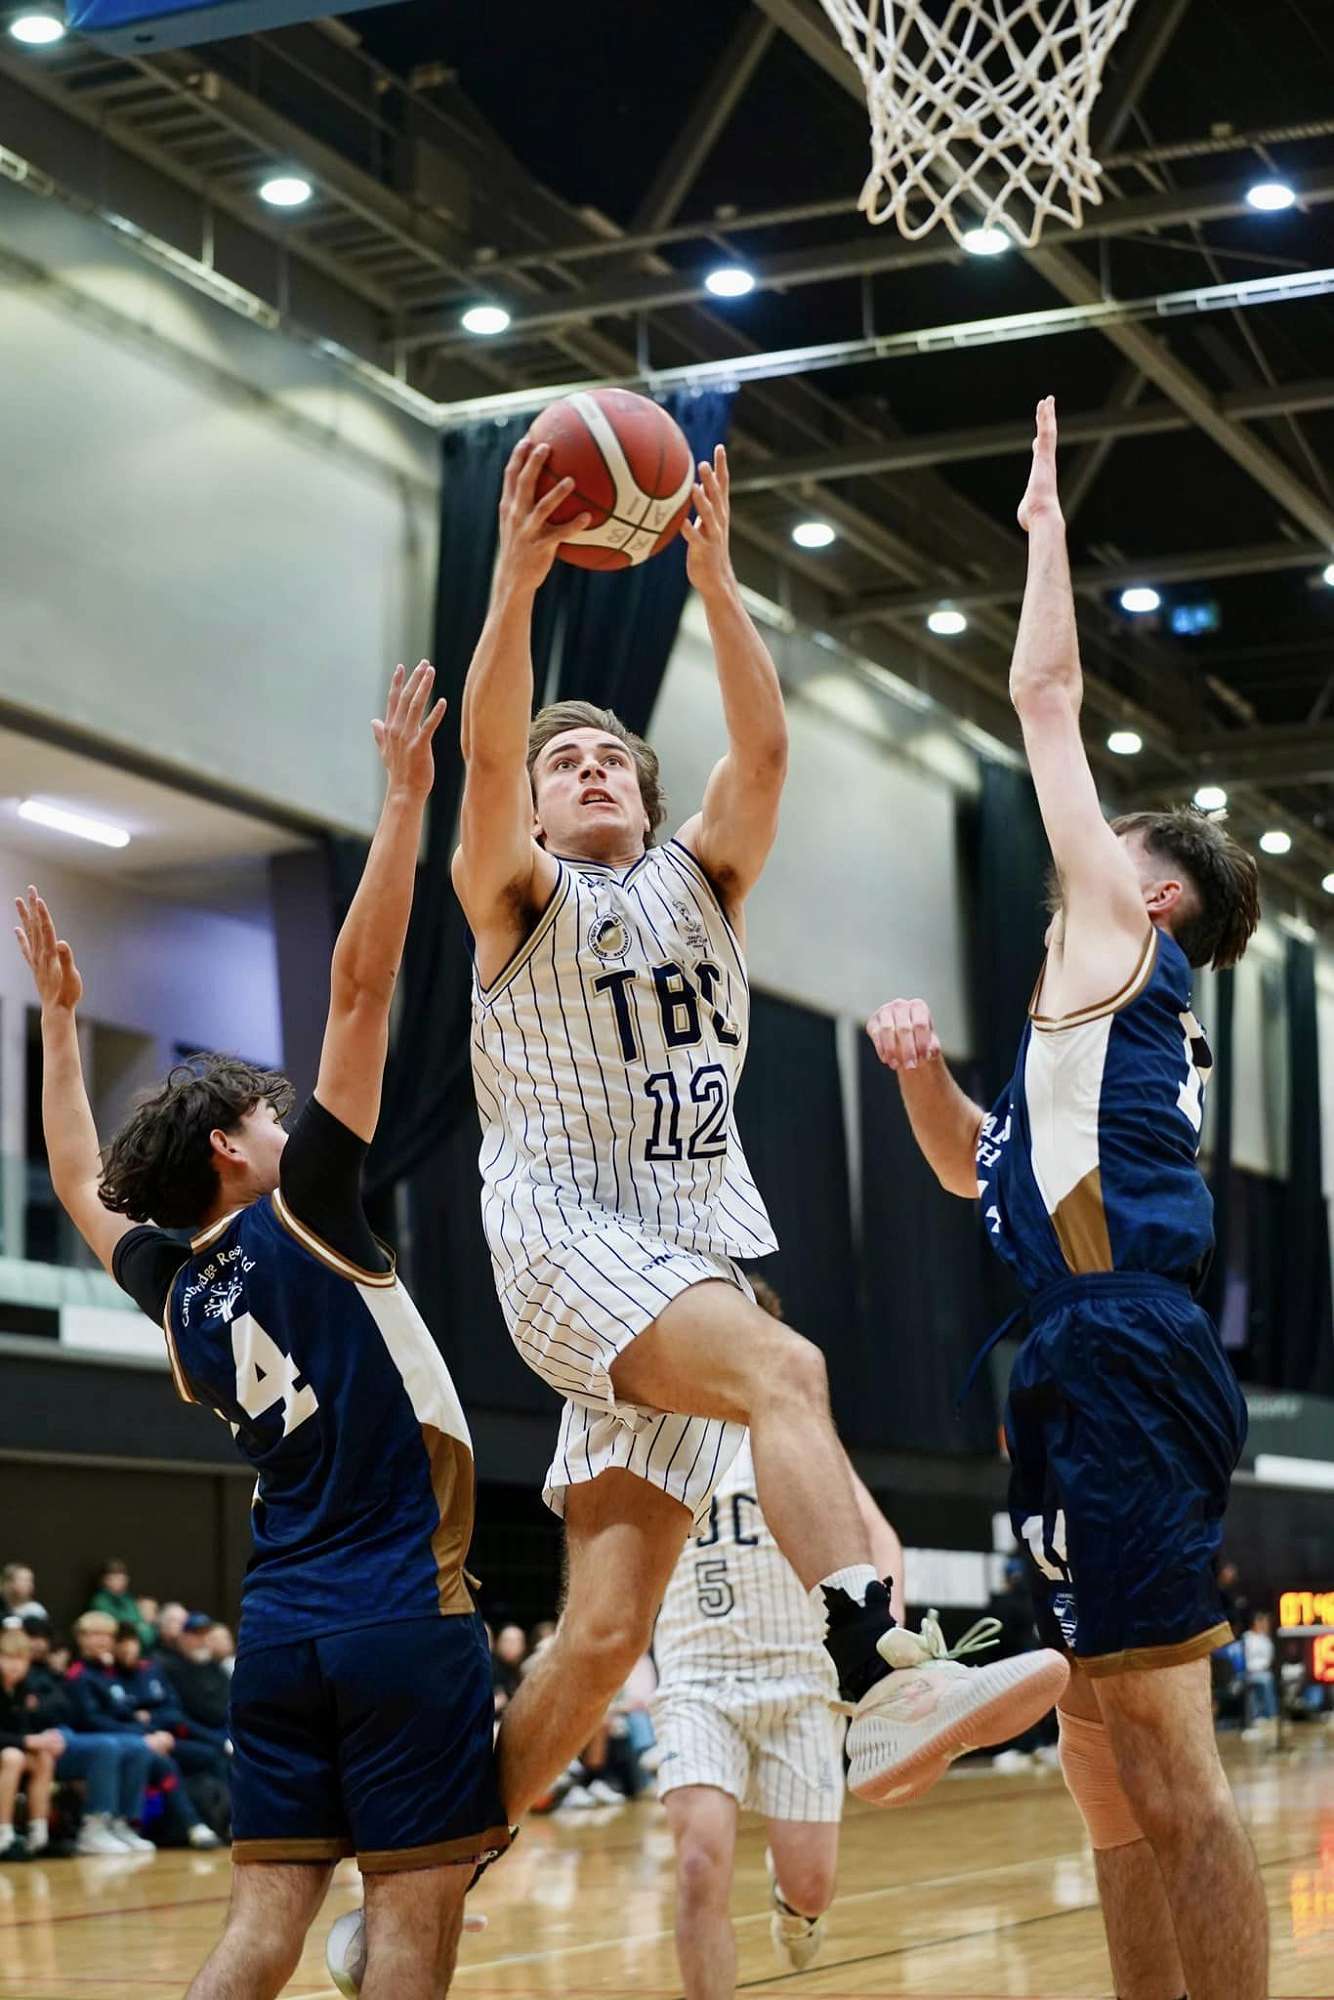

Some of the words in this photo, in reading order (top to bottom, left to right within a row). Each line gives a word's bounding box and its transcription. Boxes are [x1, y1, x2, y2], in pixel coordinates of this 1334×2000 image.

[593, 958, 742, 1066] TBC
[644, 1063, 729, 1162] 12
[694, 1559, 736, 1618] 5
